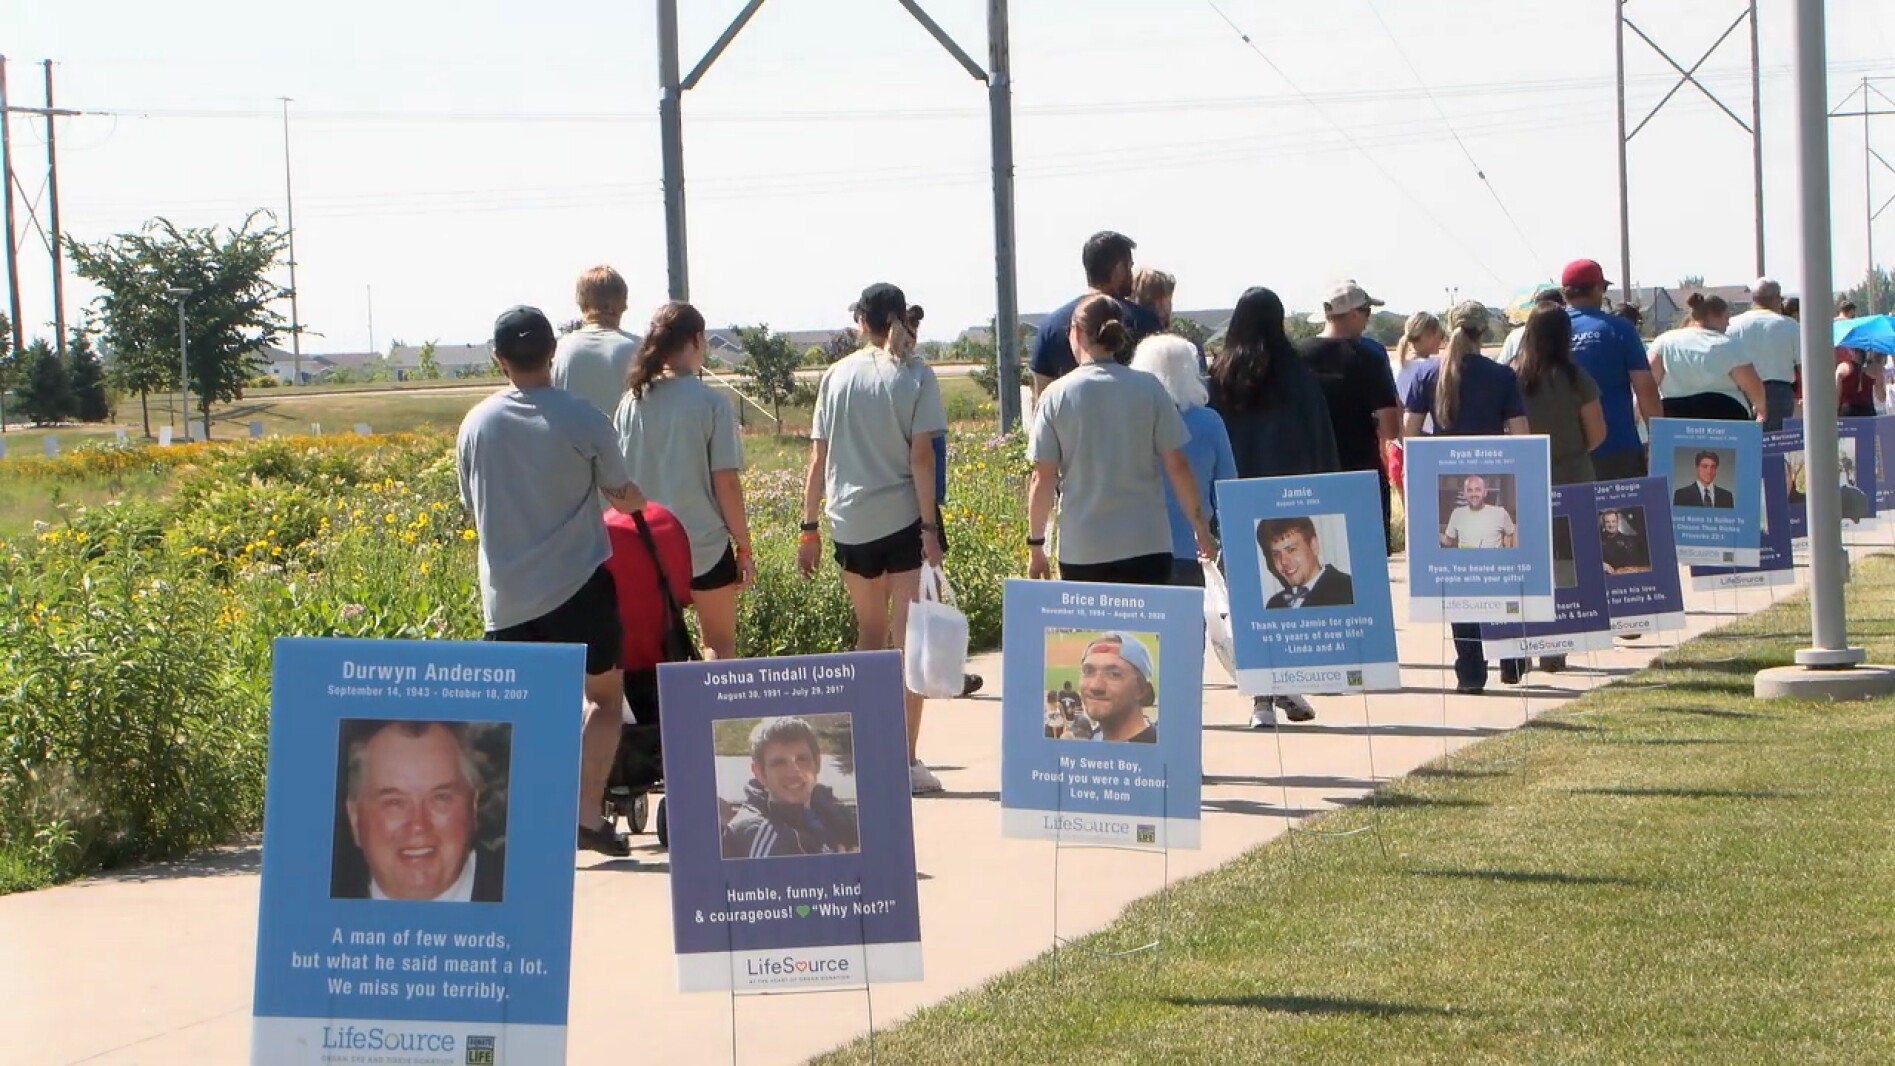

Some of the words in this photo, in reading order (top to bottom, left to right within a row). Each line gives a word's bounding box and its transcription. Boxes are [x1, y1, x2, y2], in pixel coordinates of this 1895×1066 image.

[1450, 449, 1472, 459] Ryan
[1281, 486, 1313, 498] Jamie
[1428, 564, 1450, 573] Ryan,
[1435, 575, 1461, 584] people
[1463, 574, 1480, 582] with
[1483, 575, 1501, 583] your
[1611, 587, 1628, 596] miss
[1629, 586, 1640, 594] his
[1641, 585, 1656, 593] love
[1062, 592, 1095, 605] Brice
[1099, 594, 1145, 608] Brenno
[1556, 602, 1581, 611] hearts
[1611, 596, 1623, 605] for
[1623, 595, 1645, 604] family
[1113, 610, 1138, 620] August
[1569, 611, 1575, 619] &
[1577, 609, 1598, 619] Sarah
[1250, 621, 1278, 631] Thank
[1280, 621, 1297, 631] you
[1300, 618, 1326, 629] Jamie
[1329, 617, 1342, 627] for
[1345, 616, 1373, 627] giving
[1611, 620, 1650, 630] eSource
[1262, 634, 1273, 642] us
[1275, 633, 1282, 642] 9
[1284, 632, 1309, 643] years
[1312, 630, 1321, 640] of
[1324, 631, 1342, 639] new
[1316, 643, 1332, 652] and
[1519, 640, 1575, 651] LifeSource
[342, 661, 417, 684] Durwyn
[424, 663, 516, 683] Anderson
[703, 671, 754, 686] Joshua
[758, 667, 807, 682] Tindall
[812, 663, 856, 682] (Josh)
[1272, 670, 1342, 684] LifeSource
[327, 685, 383, 697] September
[387, 686, 402, 697] 14,
[406, 686, 430, 697] 1943
[442, 687, 482, 699] October
[486, 688, 500, 699] 18,
[504, 689, 529, 700] 2007
[717, 691, 747, 702] August
[763, 688, 781, 699] 1991
[791, 686, 809, 698] July
[826, 684, 845, 695] 2017
[1059, 756, 1076, 769] My
[1080, 757, 1114, 770] Sweet
[1118, 759, 1142, 773] Boy,
[1032, 769, 1064, 782] Proud
[1068, 773, 1088, 785] you
[1092, 774, 1119, 785] were
[1123, 776, 1131, 786] a
[1134, 776, 1169, 789] donor.
[1070, 787, 1100, 801] Love,
[1103, 788, 1131, 801] Mom
[1043, 815, 1130, 835] LifeSource
[727, 886, 782, 903] Humble,
[786, 886, 828, 900] funny,
[832, 882, 862, 898] kind
[695, 909, 704, 924] &
[709, 905, 794, 924] courageous!
[332, 927, 343, 944] A
[350, 930, 386, 945] man
[393, 929, 411, 946] of
[416, 929, 448, 947] few
[454, 932, 511, 950] words,
[292, 951, 320, 968] but
[326, 952, 368, 970] what
[375, 954, 395, 970] he
[401, 955, 437, 972] said
[444, 957, 497, 974] meant
[503, 961, 513, 974] a
[520, 958, 548, 975] lot.
[327, 977, 352, 995] We
[359, 979, 399, 996] miss
[406, 983, 435, 1000] you
[443, 980, 510, 1002] terribly.
[322, 1026, 455, 1051] LifeSource
[468, 1050, 491, 1063] LIFE
